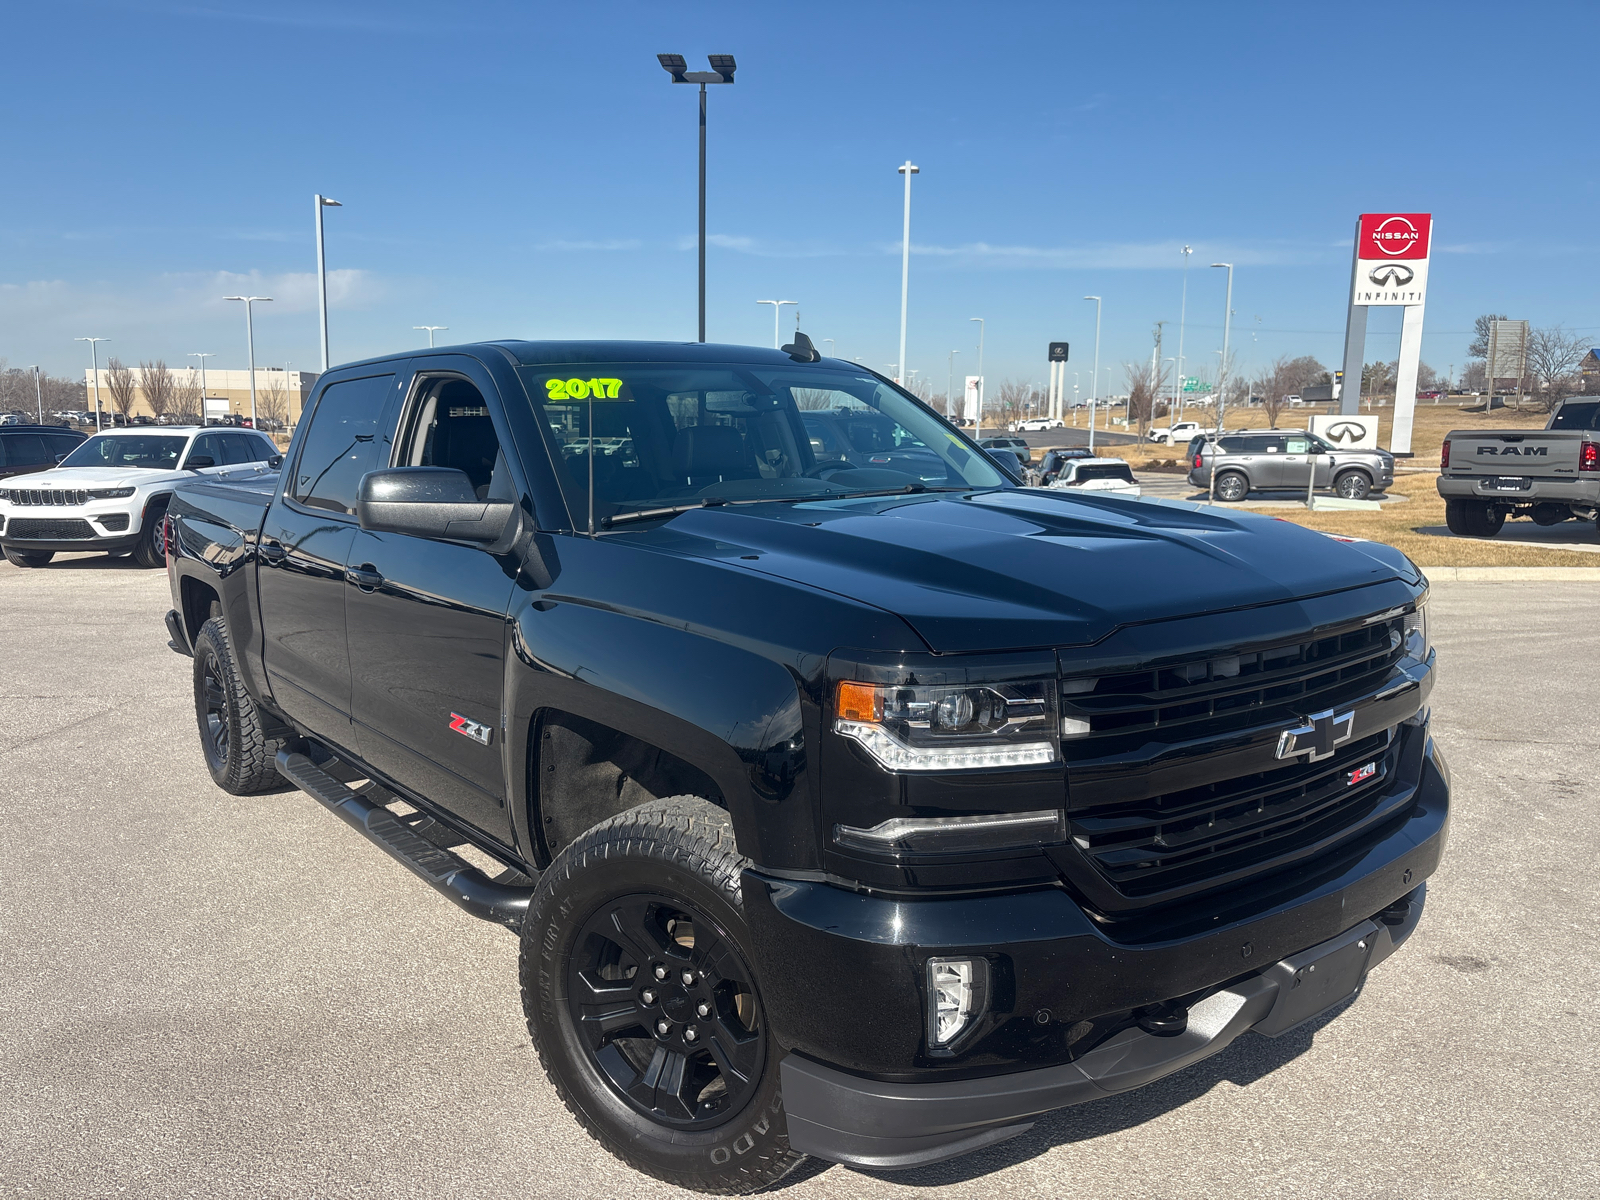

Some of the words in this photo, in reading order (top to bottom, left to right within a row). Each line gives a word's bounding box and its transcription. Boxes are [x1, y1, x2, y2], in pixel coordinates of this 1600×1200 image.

[1372, 232, 1419, 240] NISSAN
[1357, 292, 1422, 301] INFINITI
[545, 378, 623, 400] 2017
[1476, 446, 1549, 456] RAM
[449, 711, 493, 746] Z71
[1347, 762, 1376, 786] Z71
[541, 914, 560, 962] FURY
